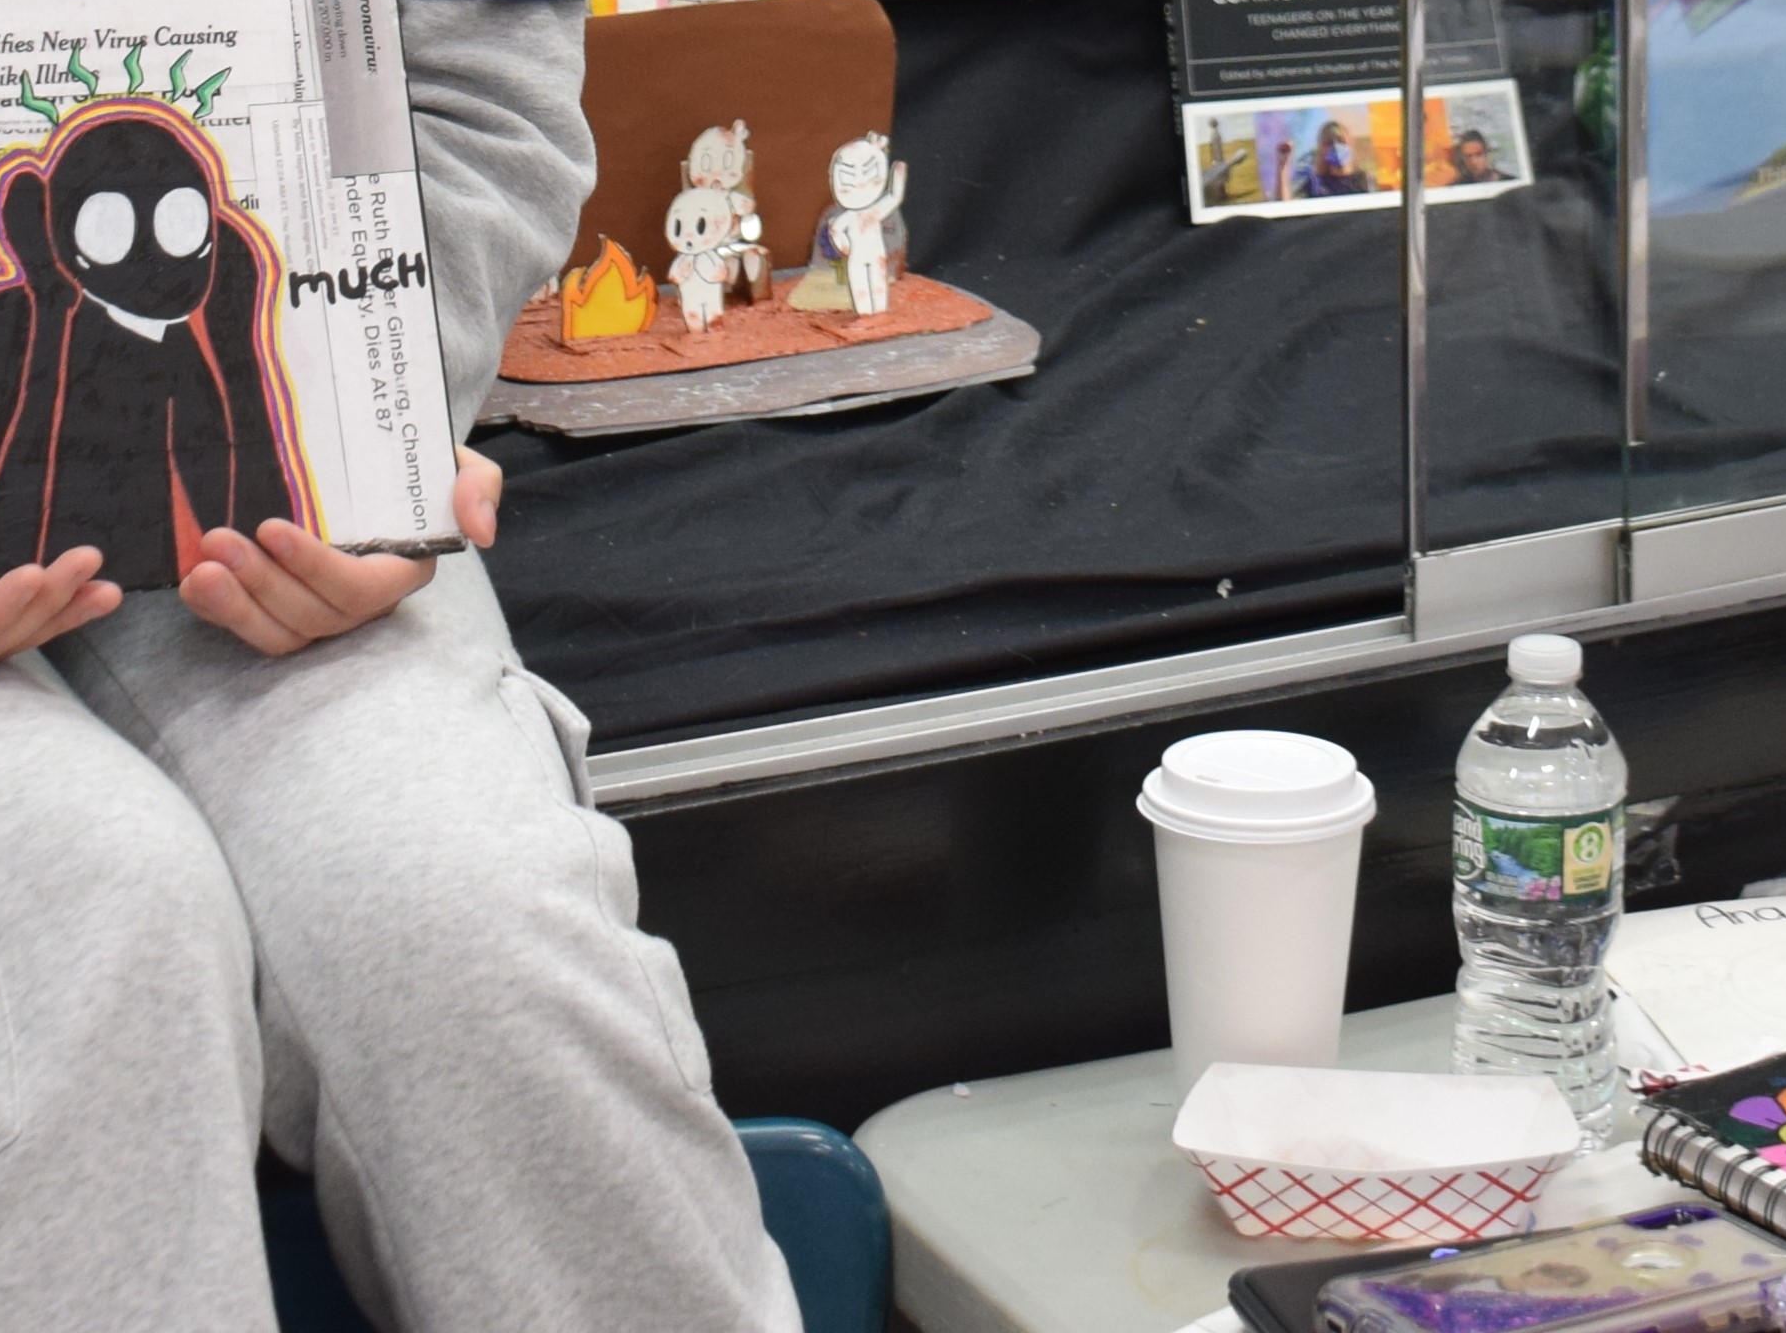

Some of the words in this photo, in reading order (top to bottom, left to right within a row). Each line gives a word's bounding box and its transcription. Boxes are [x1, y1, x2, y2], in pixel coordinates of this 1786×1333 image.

[40, 30, 87, 53] New
[94, 27, 149, 50] Virus
[153, 23, 239, 49] Causing
[351, 230, 375, 318] Equlity,
[364, 324, 381, 371] Dies
[370, 190, 392, 241] Ruth
[386, 315, 412, 417] Ginsbrg,
[401, 422, 429, 532] Champion
[371, 377, 387, 401] At
[375, 408, 394, 433] 87
[1695, 903, 1786, 929] Ana
